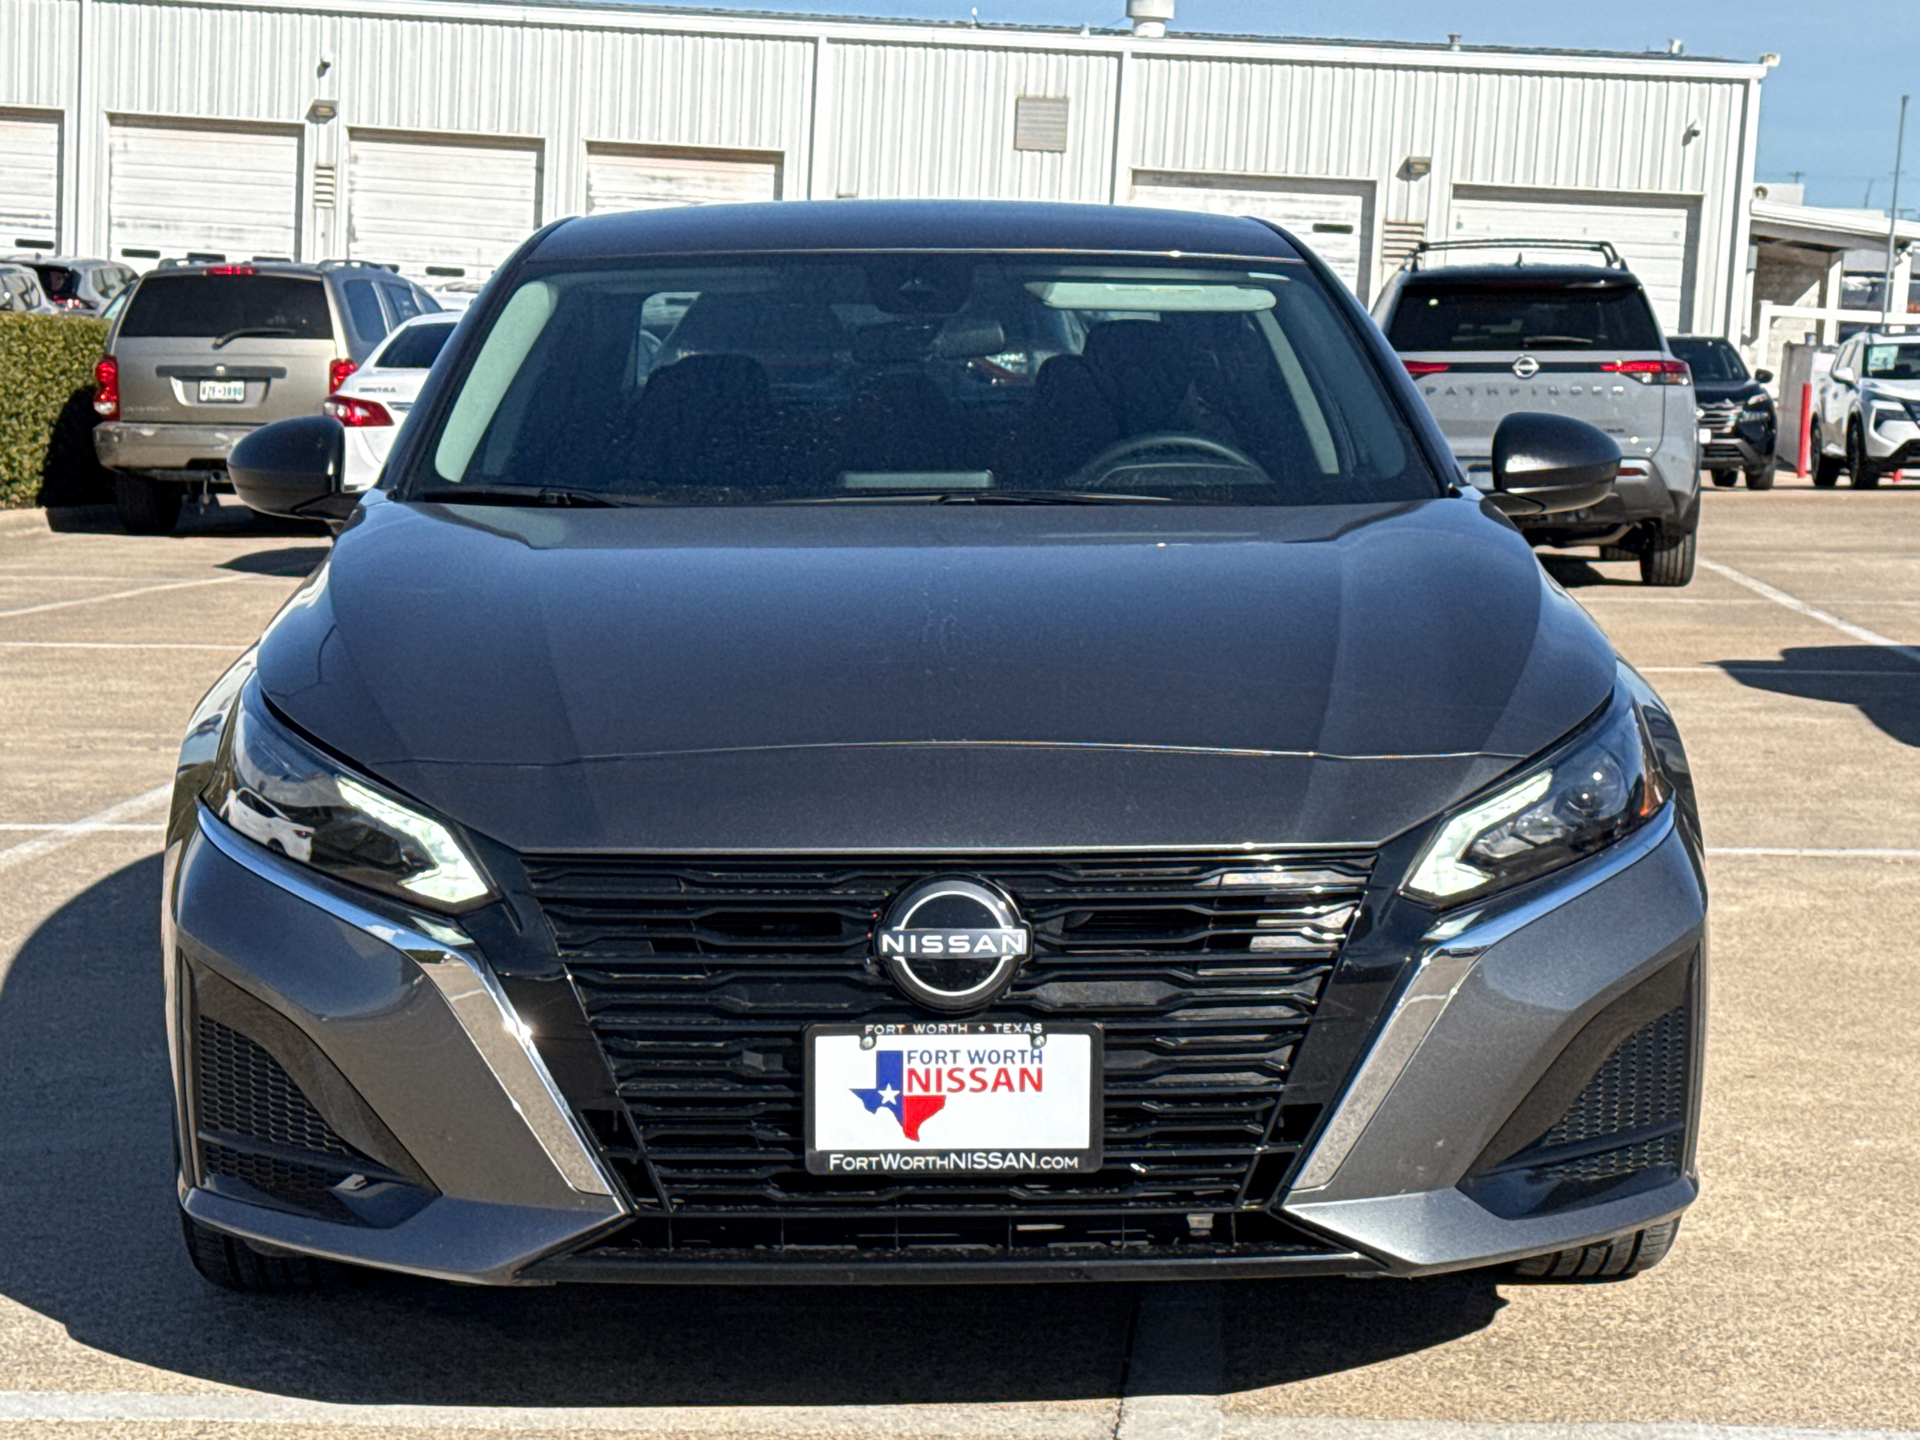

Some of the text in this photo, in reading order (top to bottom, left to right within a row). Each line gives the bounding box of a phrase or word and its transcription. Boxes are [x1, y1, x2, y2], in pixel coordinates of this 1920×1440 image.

[1425, 385, 1624, 396] PATHFINDER
[882, 934, 1024, 953] NISSAN
[865, 1023, 1042, 1034] FORT WORTH TEXAS
[907, 1050, 1043, 1065] FORT WORTH
[907, 1067, 1043, 1093] NISSAN
